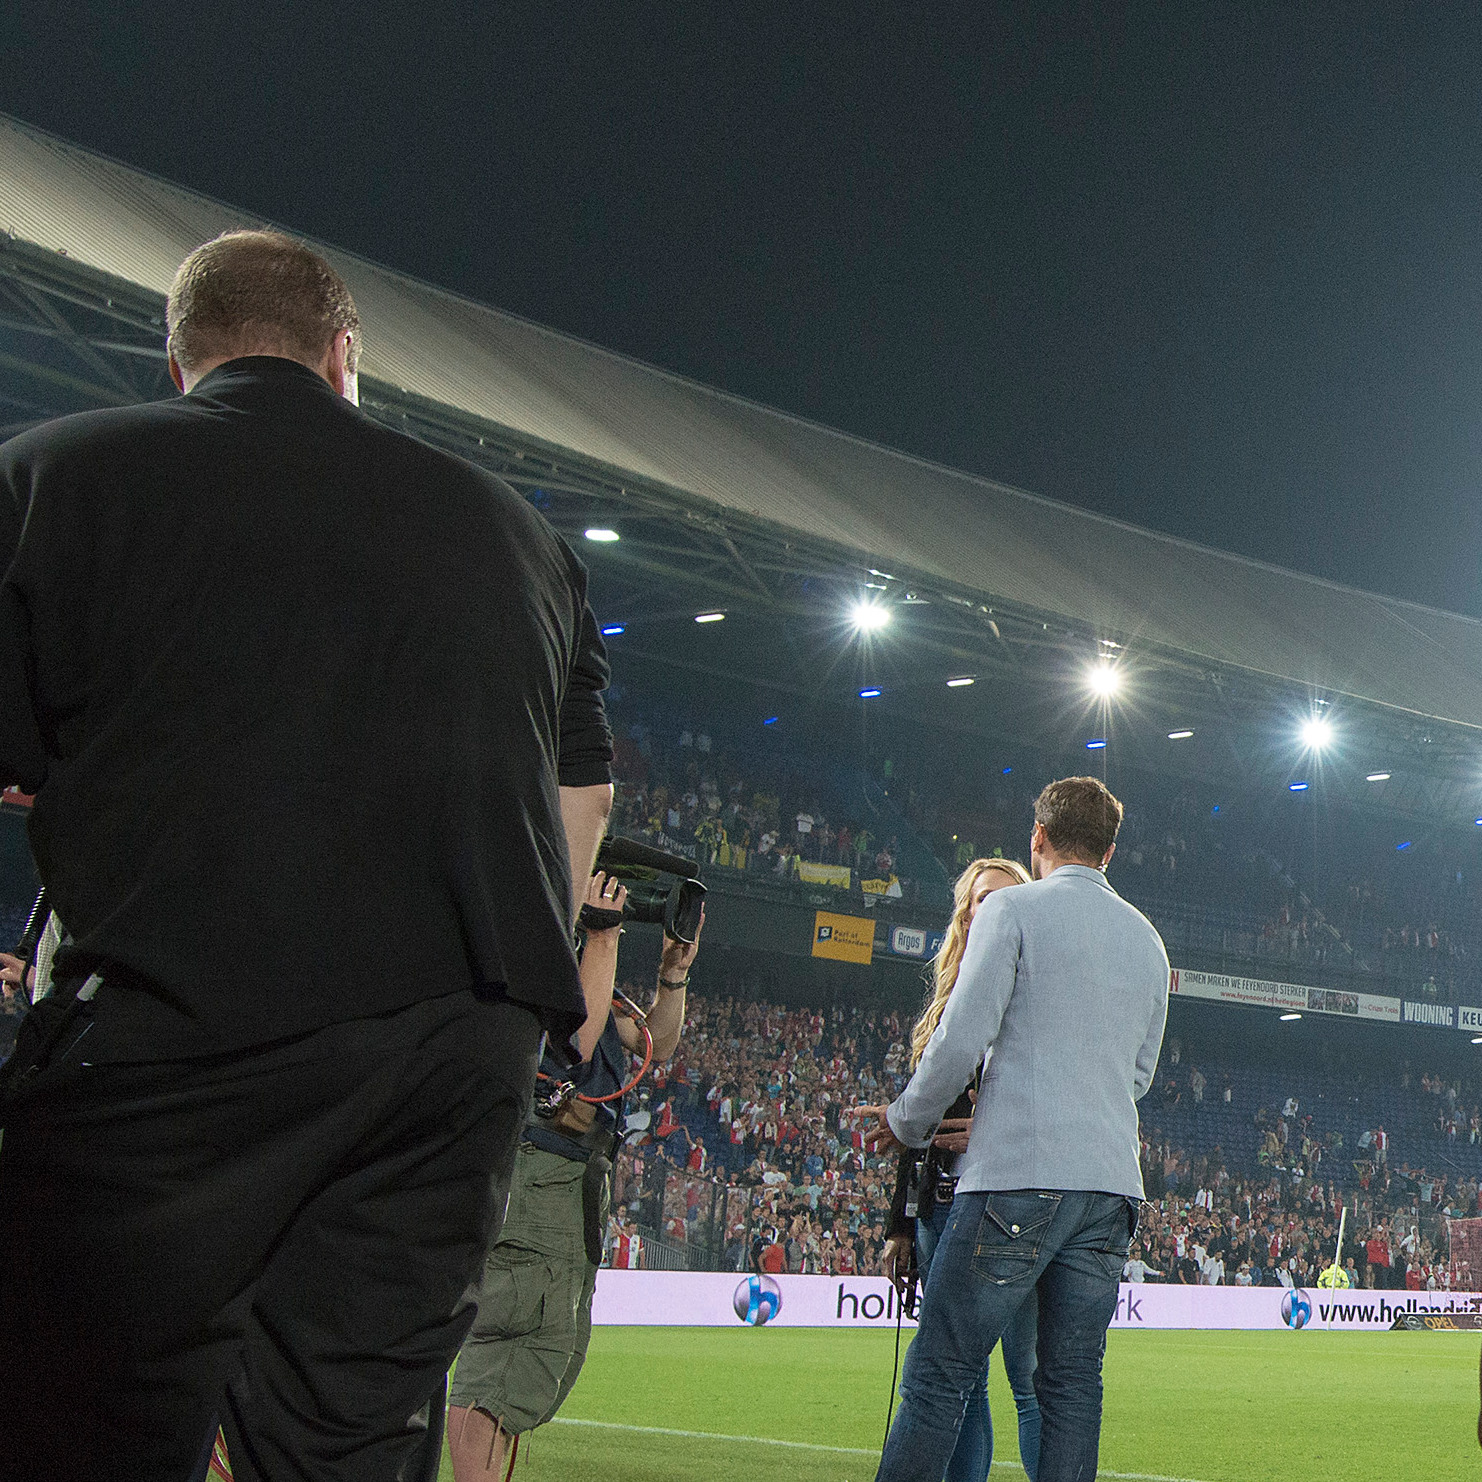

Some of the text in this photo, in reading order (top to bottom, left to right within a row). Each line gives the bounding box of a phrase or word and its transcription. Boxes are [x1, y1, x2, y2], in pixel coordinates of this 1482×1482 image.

[898, 932, 920, 951] Argos
[1184, 972, 1307, 998] SAMEN MAKEN WE FEYENOORD STERKER
[1404, 1001, 1453, 1026] WOONING
[1425, 1316, 1460, 1329] OPEL
